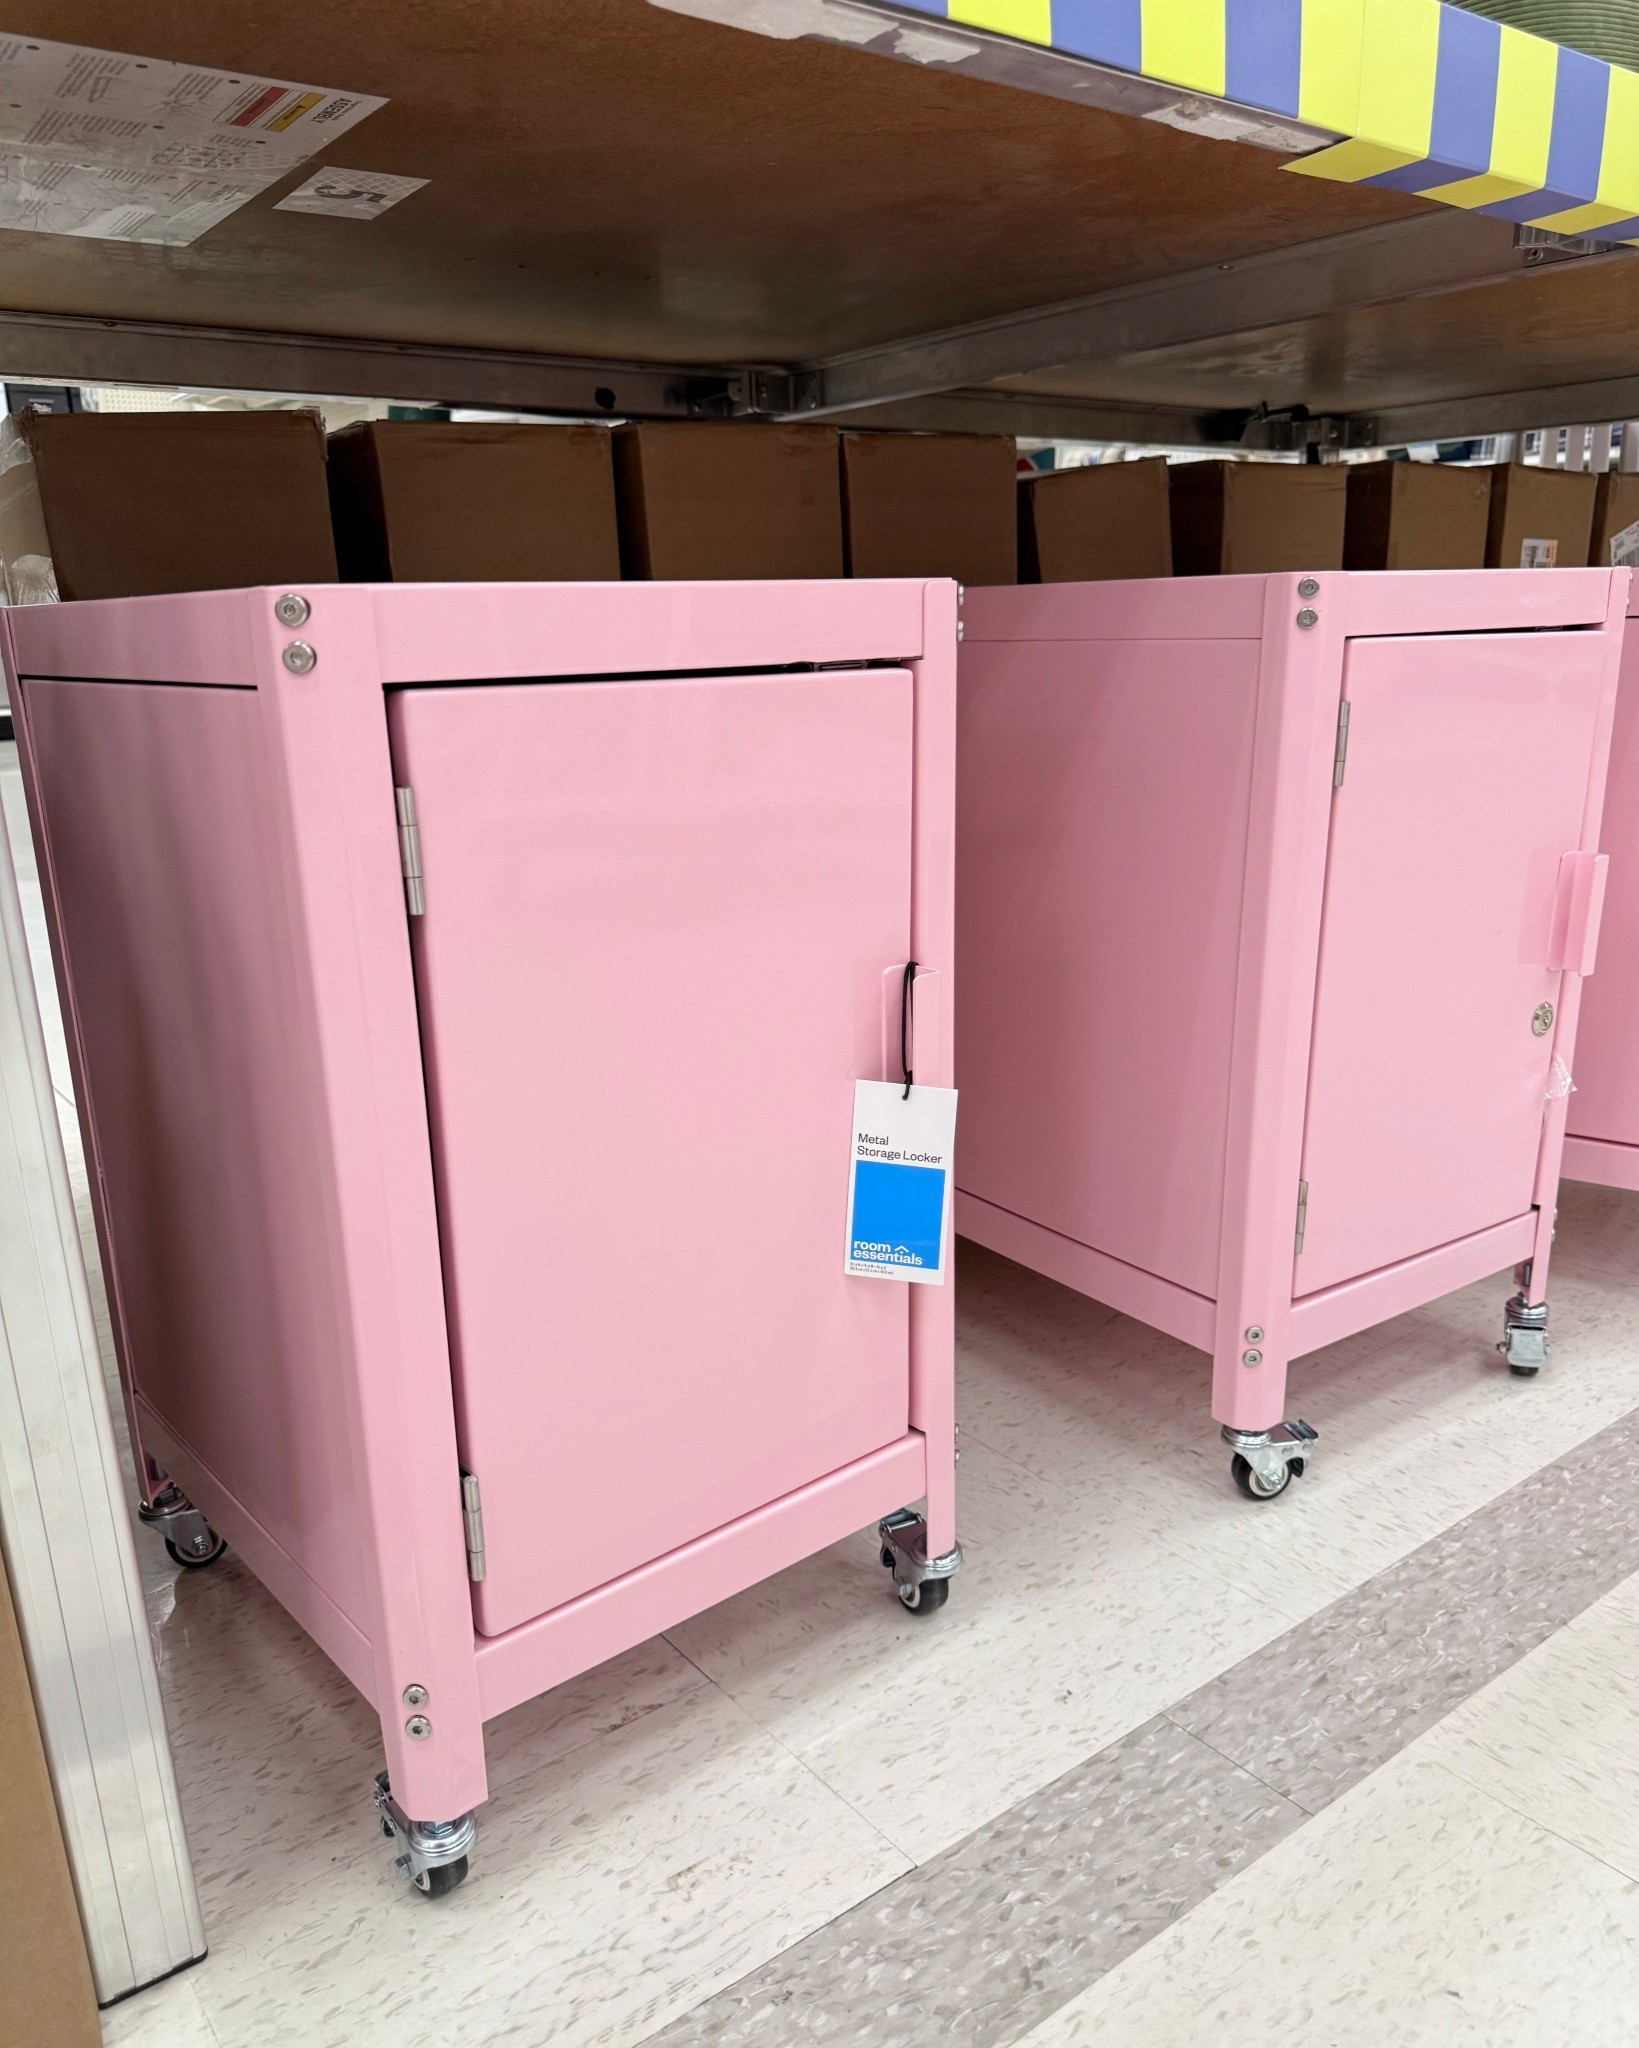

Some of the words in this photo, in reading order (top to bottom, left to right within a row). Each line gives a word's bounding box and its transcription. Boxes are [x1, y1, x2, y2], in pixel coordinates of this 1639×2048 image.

[310, 97, 352, 124] ASSEMBLY
[858, 1133, 889, 1145] Metal
[857, 1145, 901, 1160] Storage
[903, 1150, 943, 1163] Locker
[853, 1240, 891, 1252] room
[853, 1249, 923, 1265] essentials
